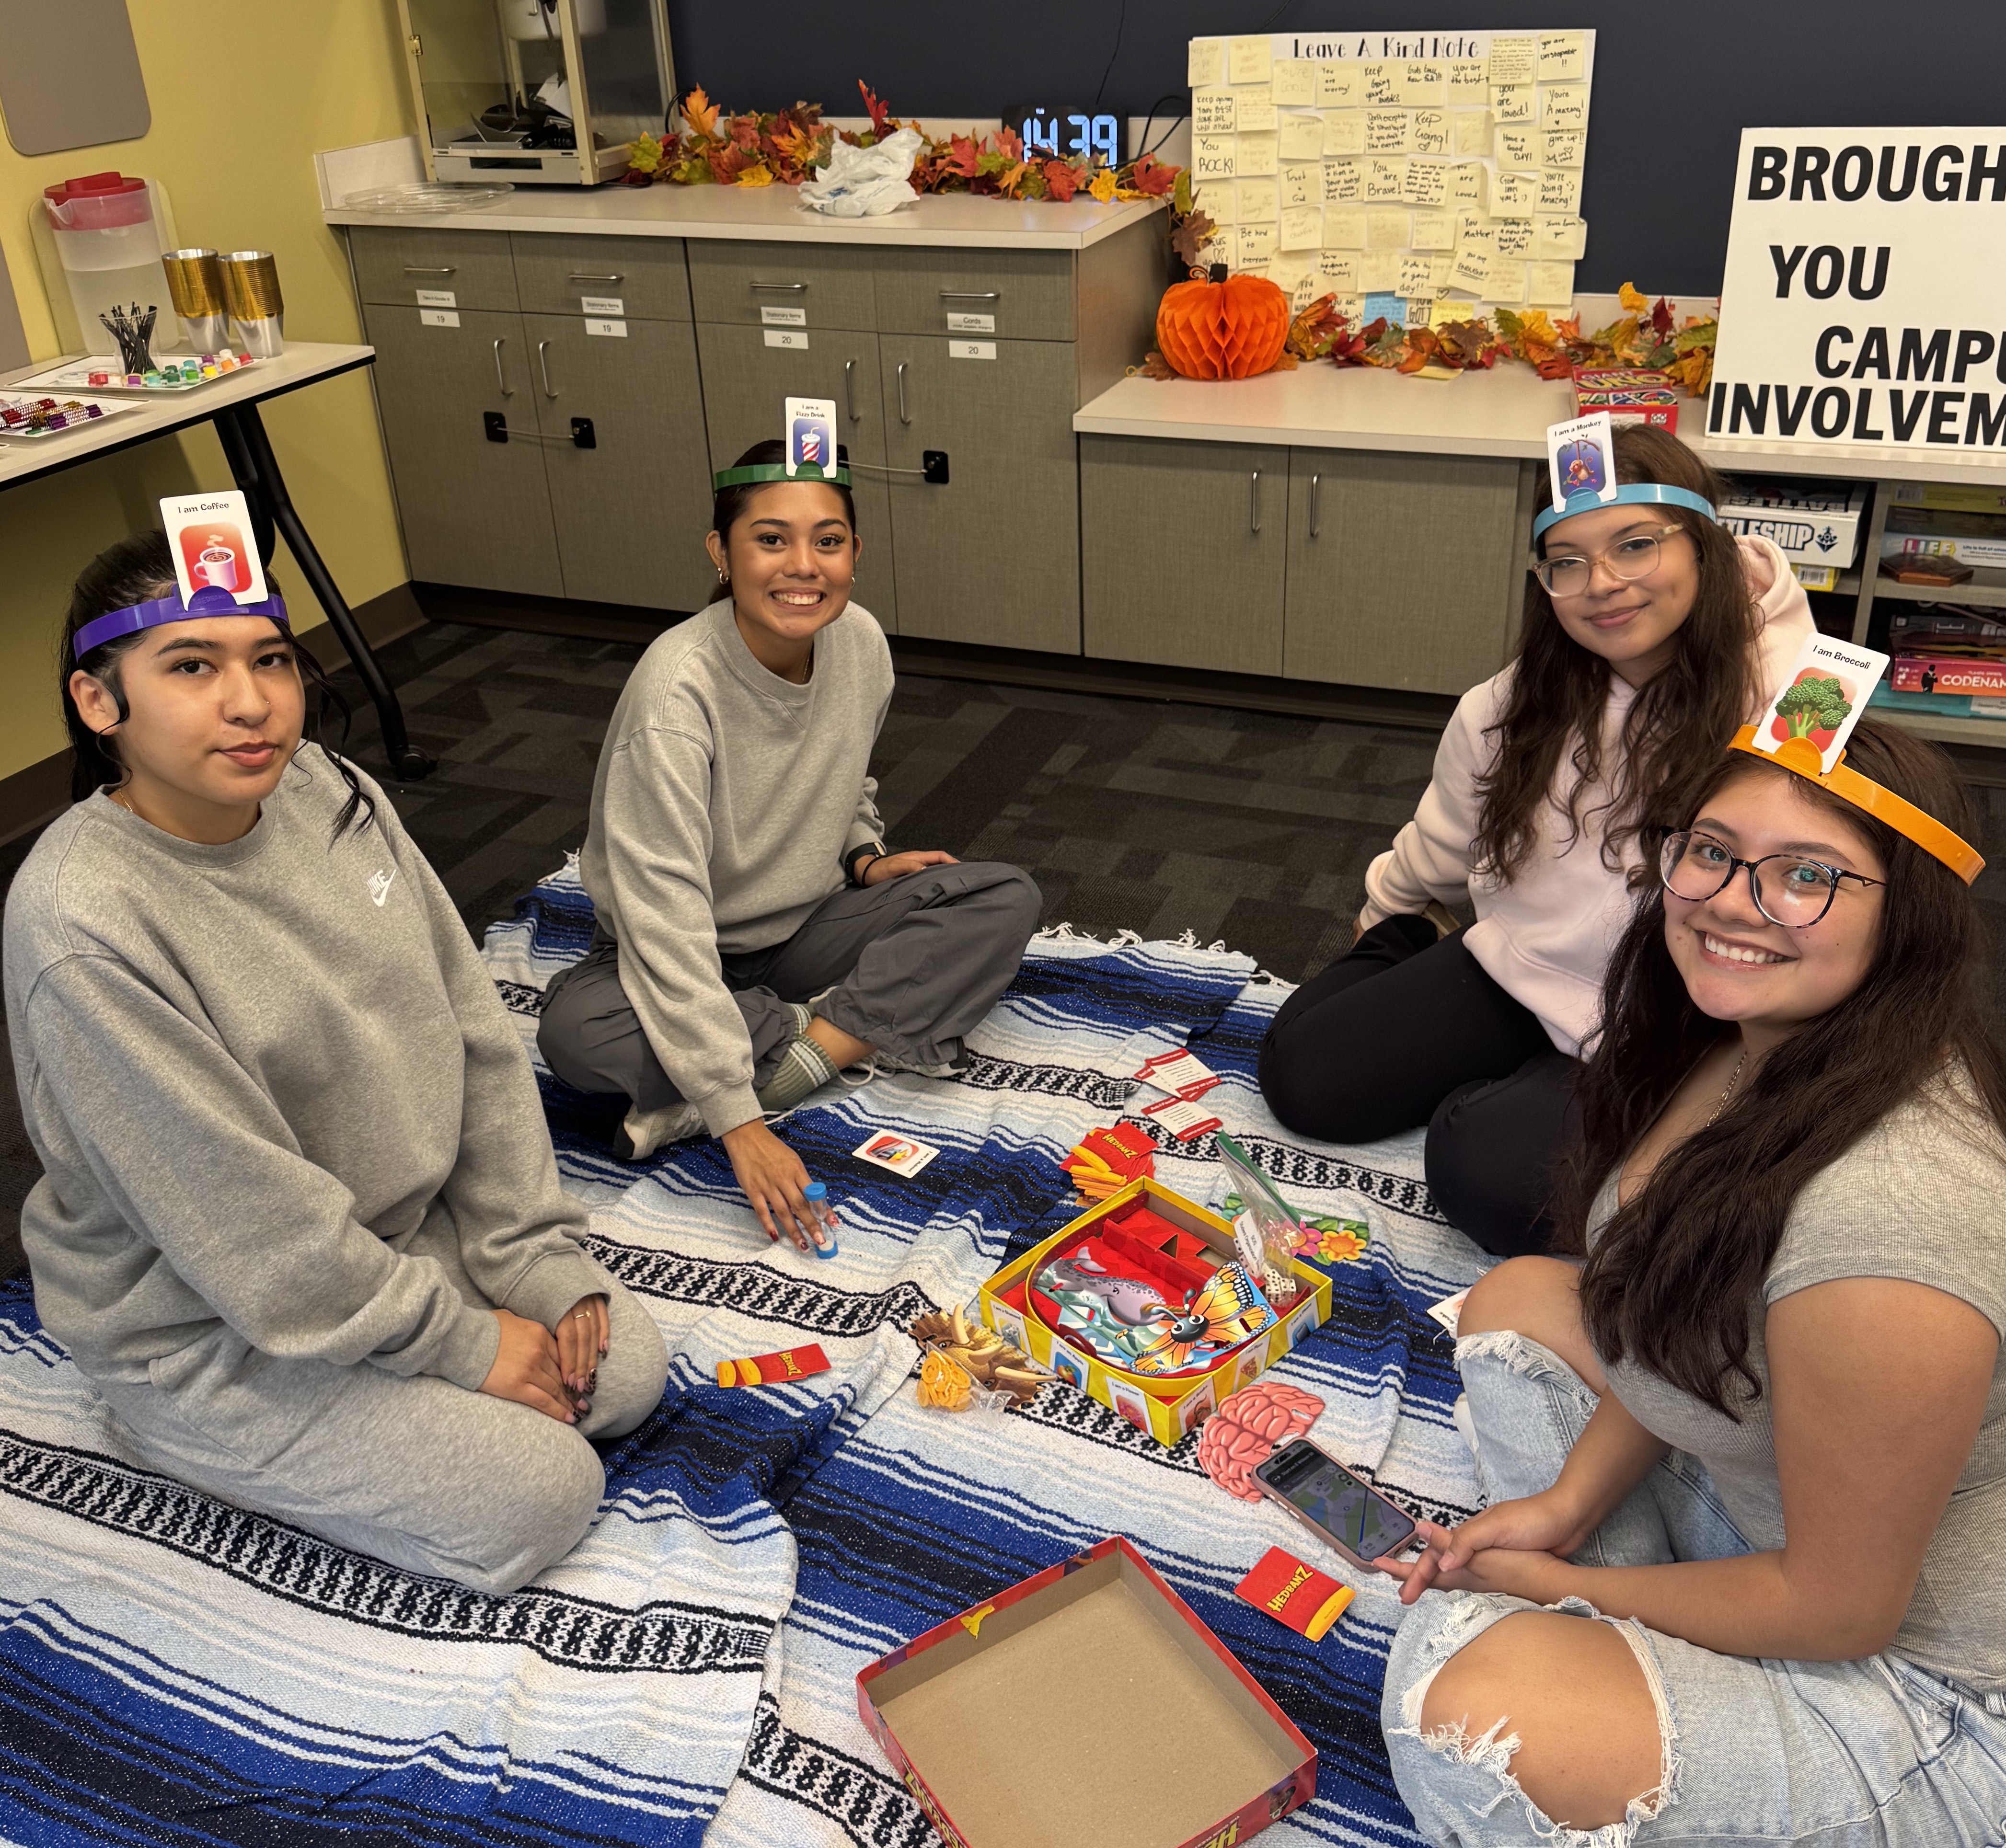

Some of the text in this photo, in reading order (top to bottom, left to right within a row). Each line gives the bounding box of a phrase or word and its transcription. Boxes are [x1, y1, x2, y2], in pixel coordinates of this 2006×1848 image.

[1294, 37, 1479, 58] Leave A Kind Note
[1497, 98, 1512, 106] are
[1501, 102, 1528, 118] loved!
[1415, 111, 1442, 127] Keep
[1200, 138, 1219, 151] You
[1199, 157, 1234, 174] ROCK!
[1372, 161, 1388, 173] You
[1748, 145, 2006, 202] BROUGH
[1367, 182, 1402, 196] Brave!
[1769, 245, 1891, 300] YOU
[782, 335, 792, 344] 20
[968, 345, 979, 355] 20
[1576, 374, 1669, 390] UNO
[1708, 382, 2006, 446] INVOLVEM
[1577, 421, 1602, 431] Monkey
[201, 502, 230, 511] Coffee
[1818, 649, 1833, 657] am
[1833, 651, 1871, 670] Broccoli
[1266, 1563, 1314, 1613] HEDBANZ
